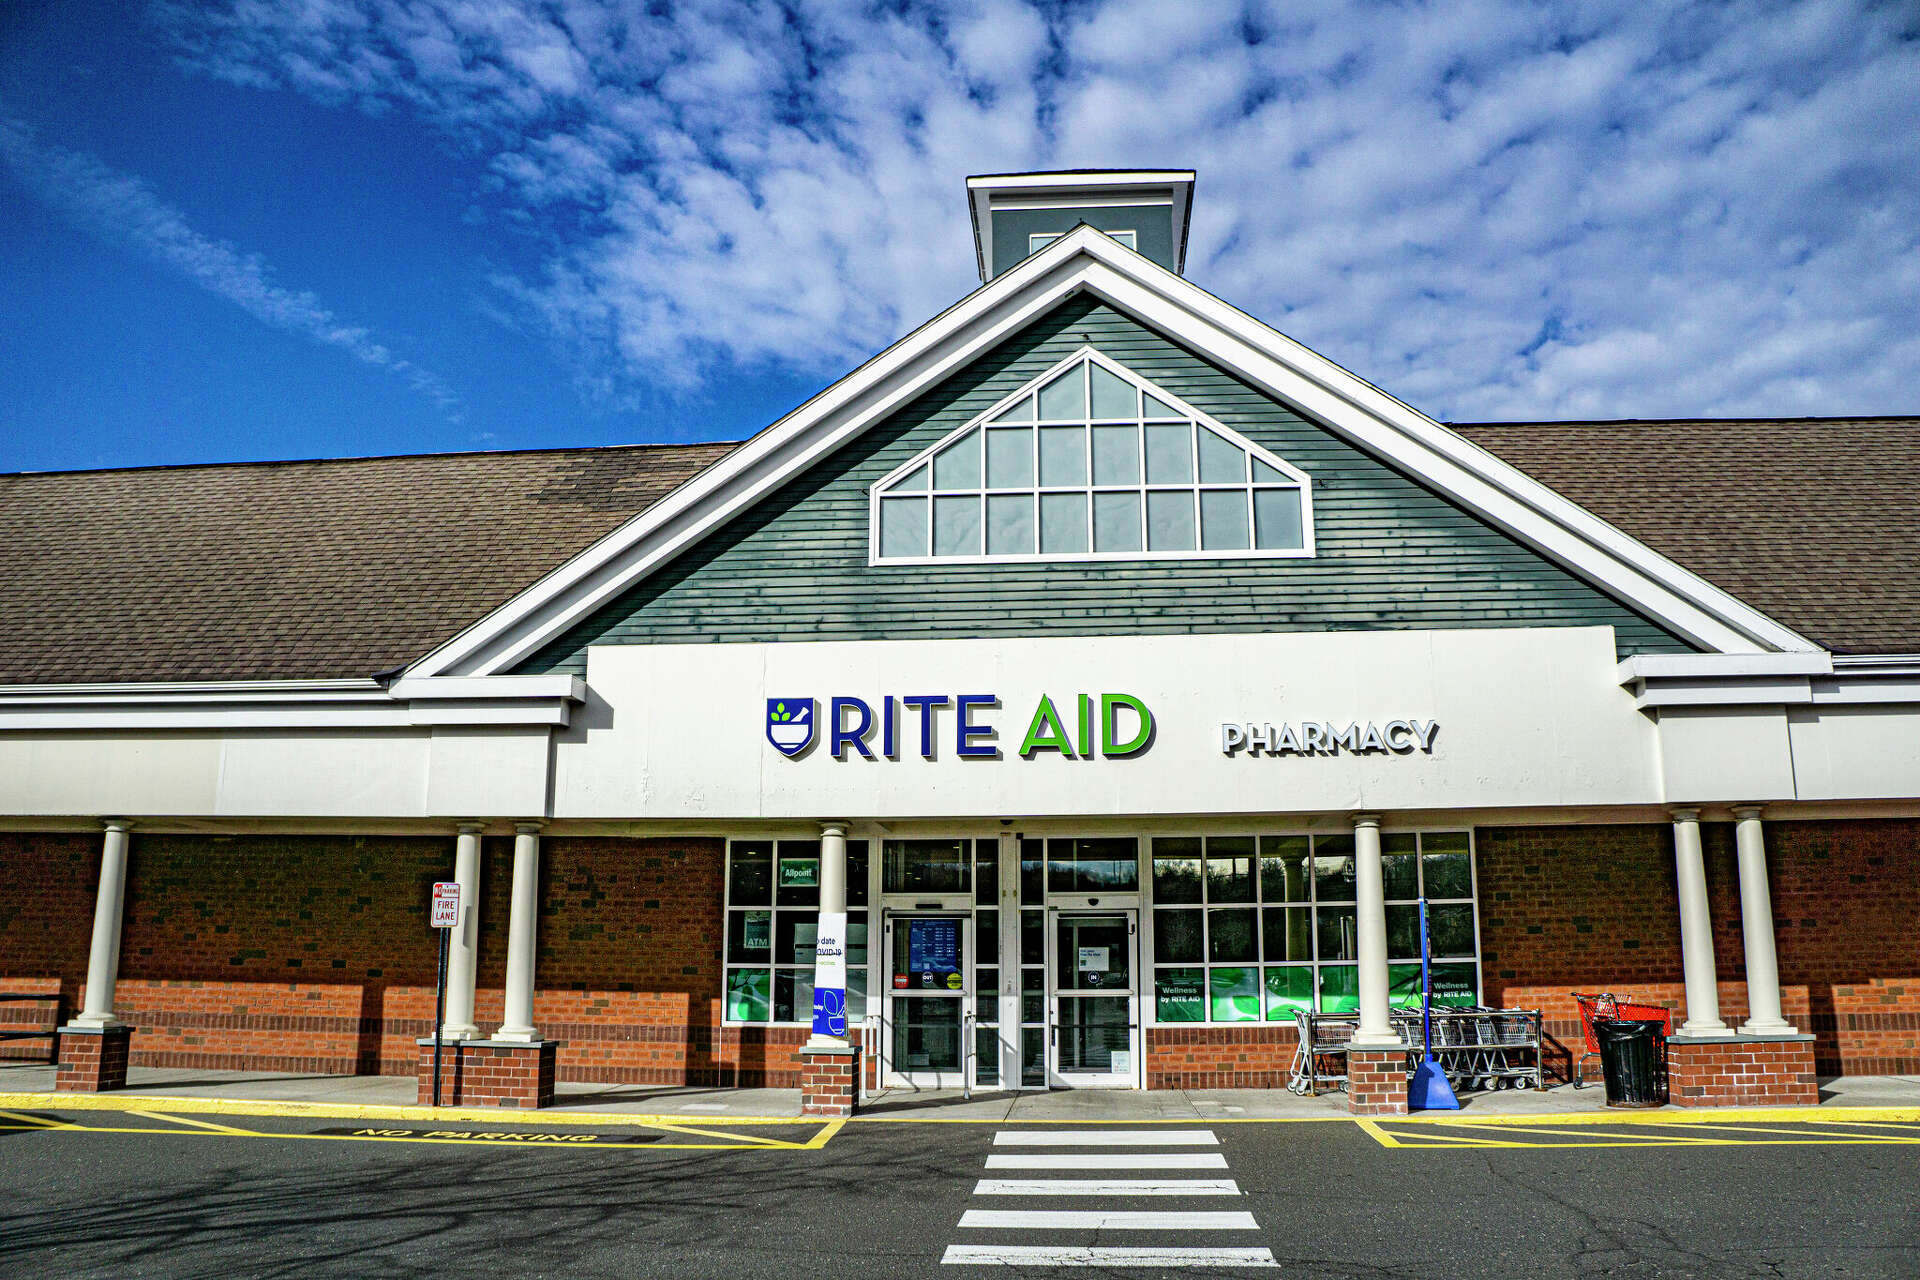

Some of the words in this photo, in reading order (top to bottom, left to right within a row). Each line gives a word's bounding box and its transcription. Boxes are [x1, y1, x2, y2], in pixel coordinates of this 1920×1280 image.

[830, 694, 1001, 759] RITE
[1018, 693, 1155, 759] AID
[1222, 719, 1438, 756] PHARMACY
[785, 868, 812, 878] Allpoint
[437, 901, 455, 909] FIRE
[435, 911, 455, 920] LANE
[748, 938, 768, 946] ATM
[821, 936, 836, 945] date
[353, 1128, 413, 1137] NO
[423, 1130, 598, 1142] PARKING
